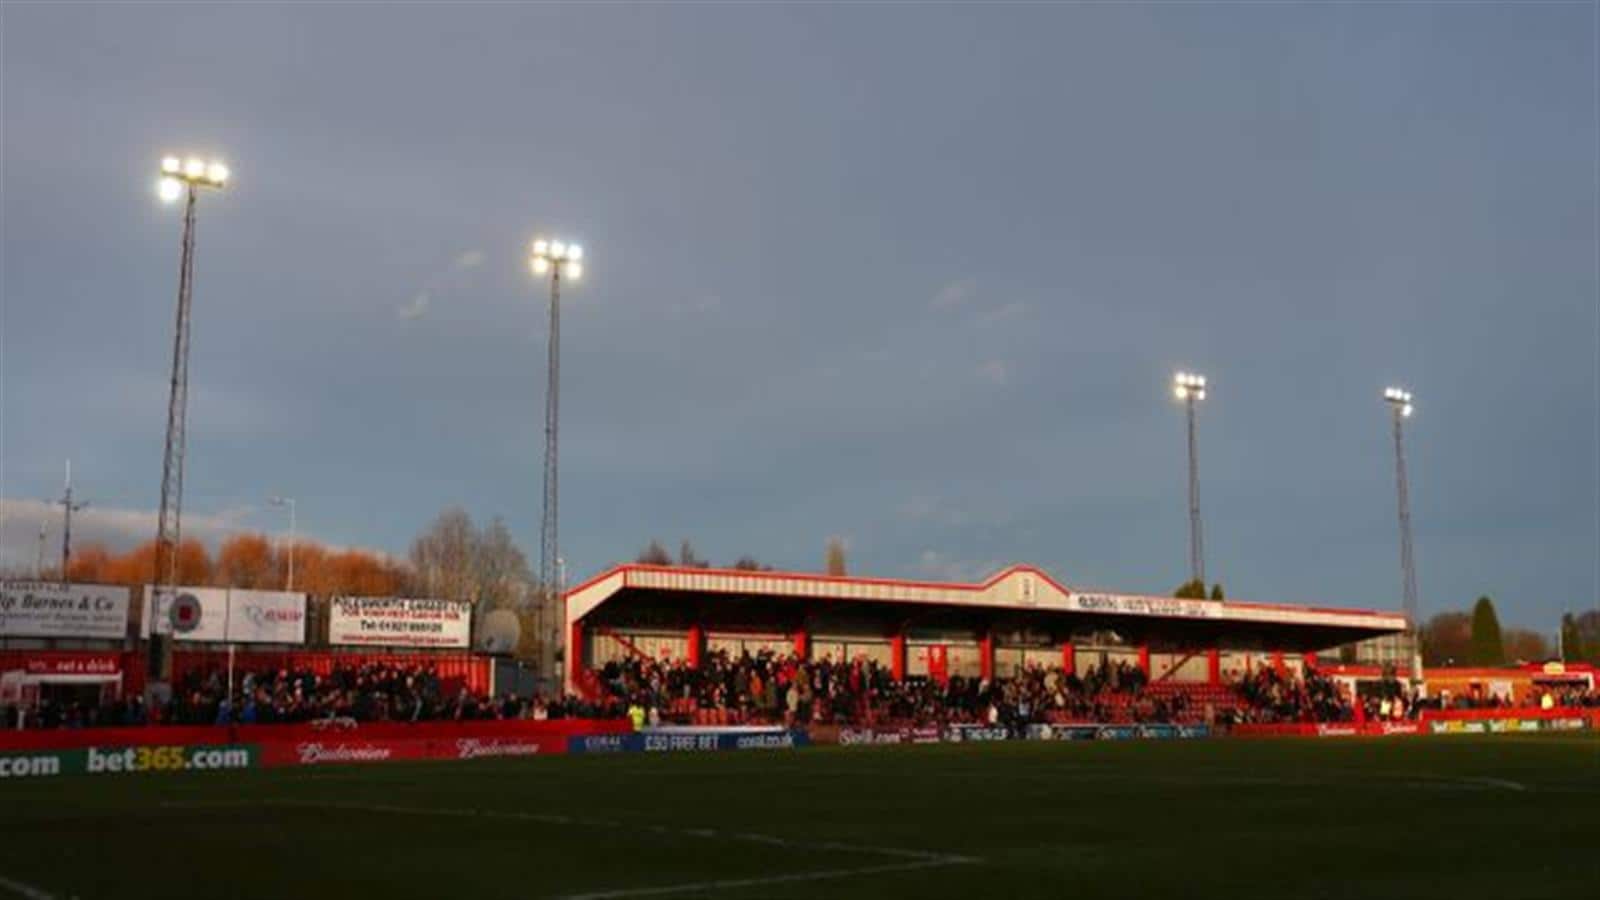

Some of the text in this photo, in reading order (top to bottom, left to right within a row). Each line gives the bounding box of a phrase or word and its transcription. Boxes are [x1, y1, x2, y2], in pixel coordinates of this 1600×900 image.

[22, 594, 74, 609] Barnes
[78, 595, 89, 610] &
[86, 658, 115, 672] drink
[699, 734, 721, 750] BET
[87, 745, 249, 772] bet365.com
